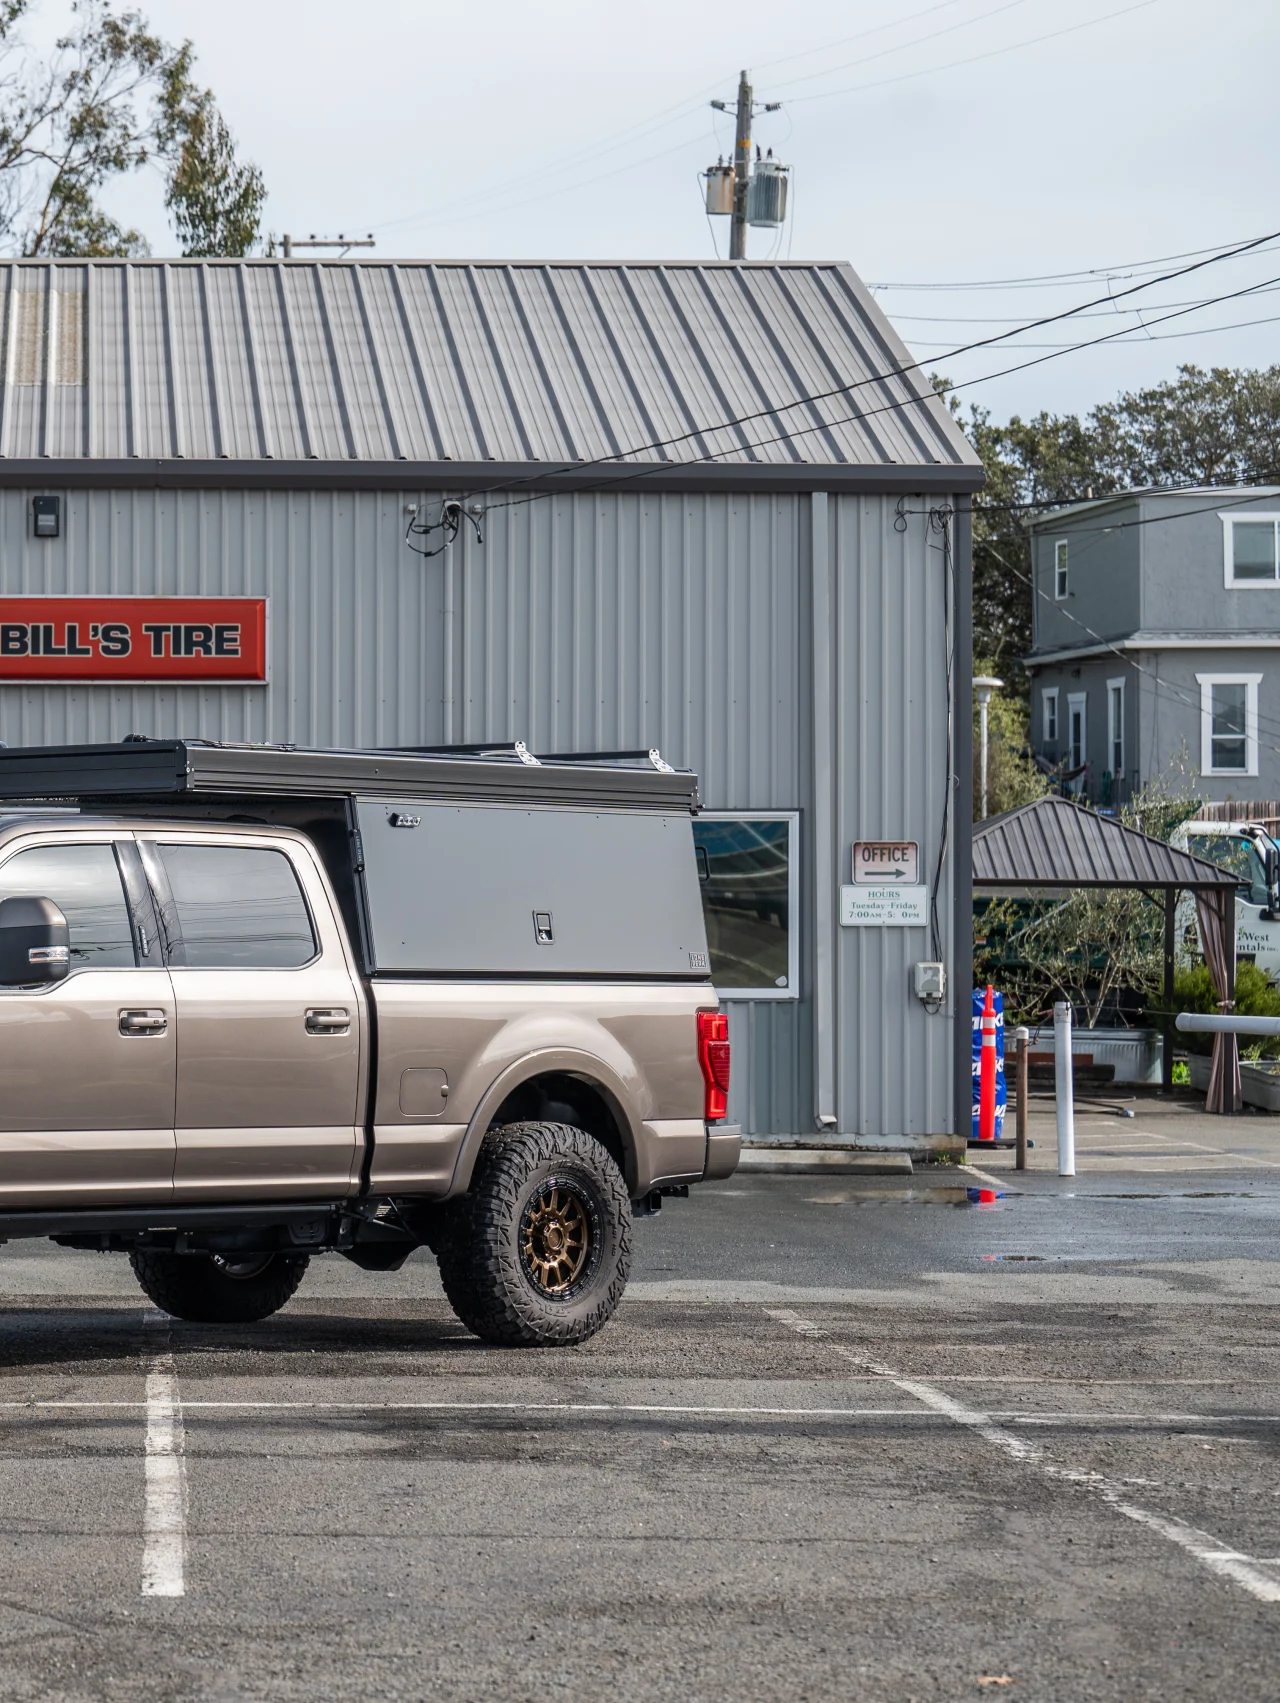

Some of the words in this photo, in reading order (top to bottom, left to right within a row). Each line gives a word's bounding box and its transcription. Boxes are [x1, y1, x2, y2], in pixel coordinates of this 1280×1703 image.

[143, 623, 242, 658] TIRE
[862, 847, 909, 862] OFFICE
[868, 891, 900, 899] HOURS
